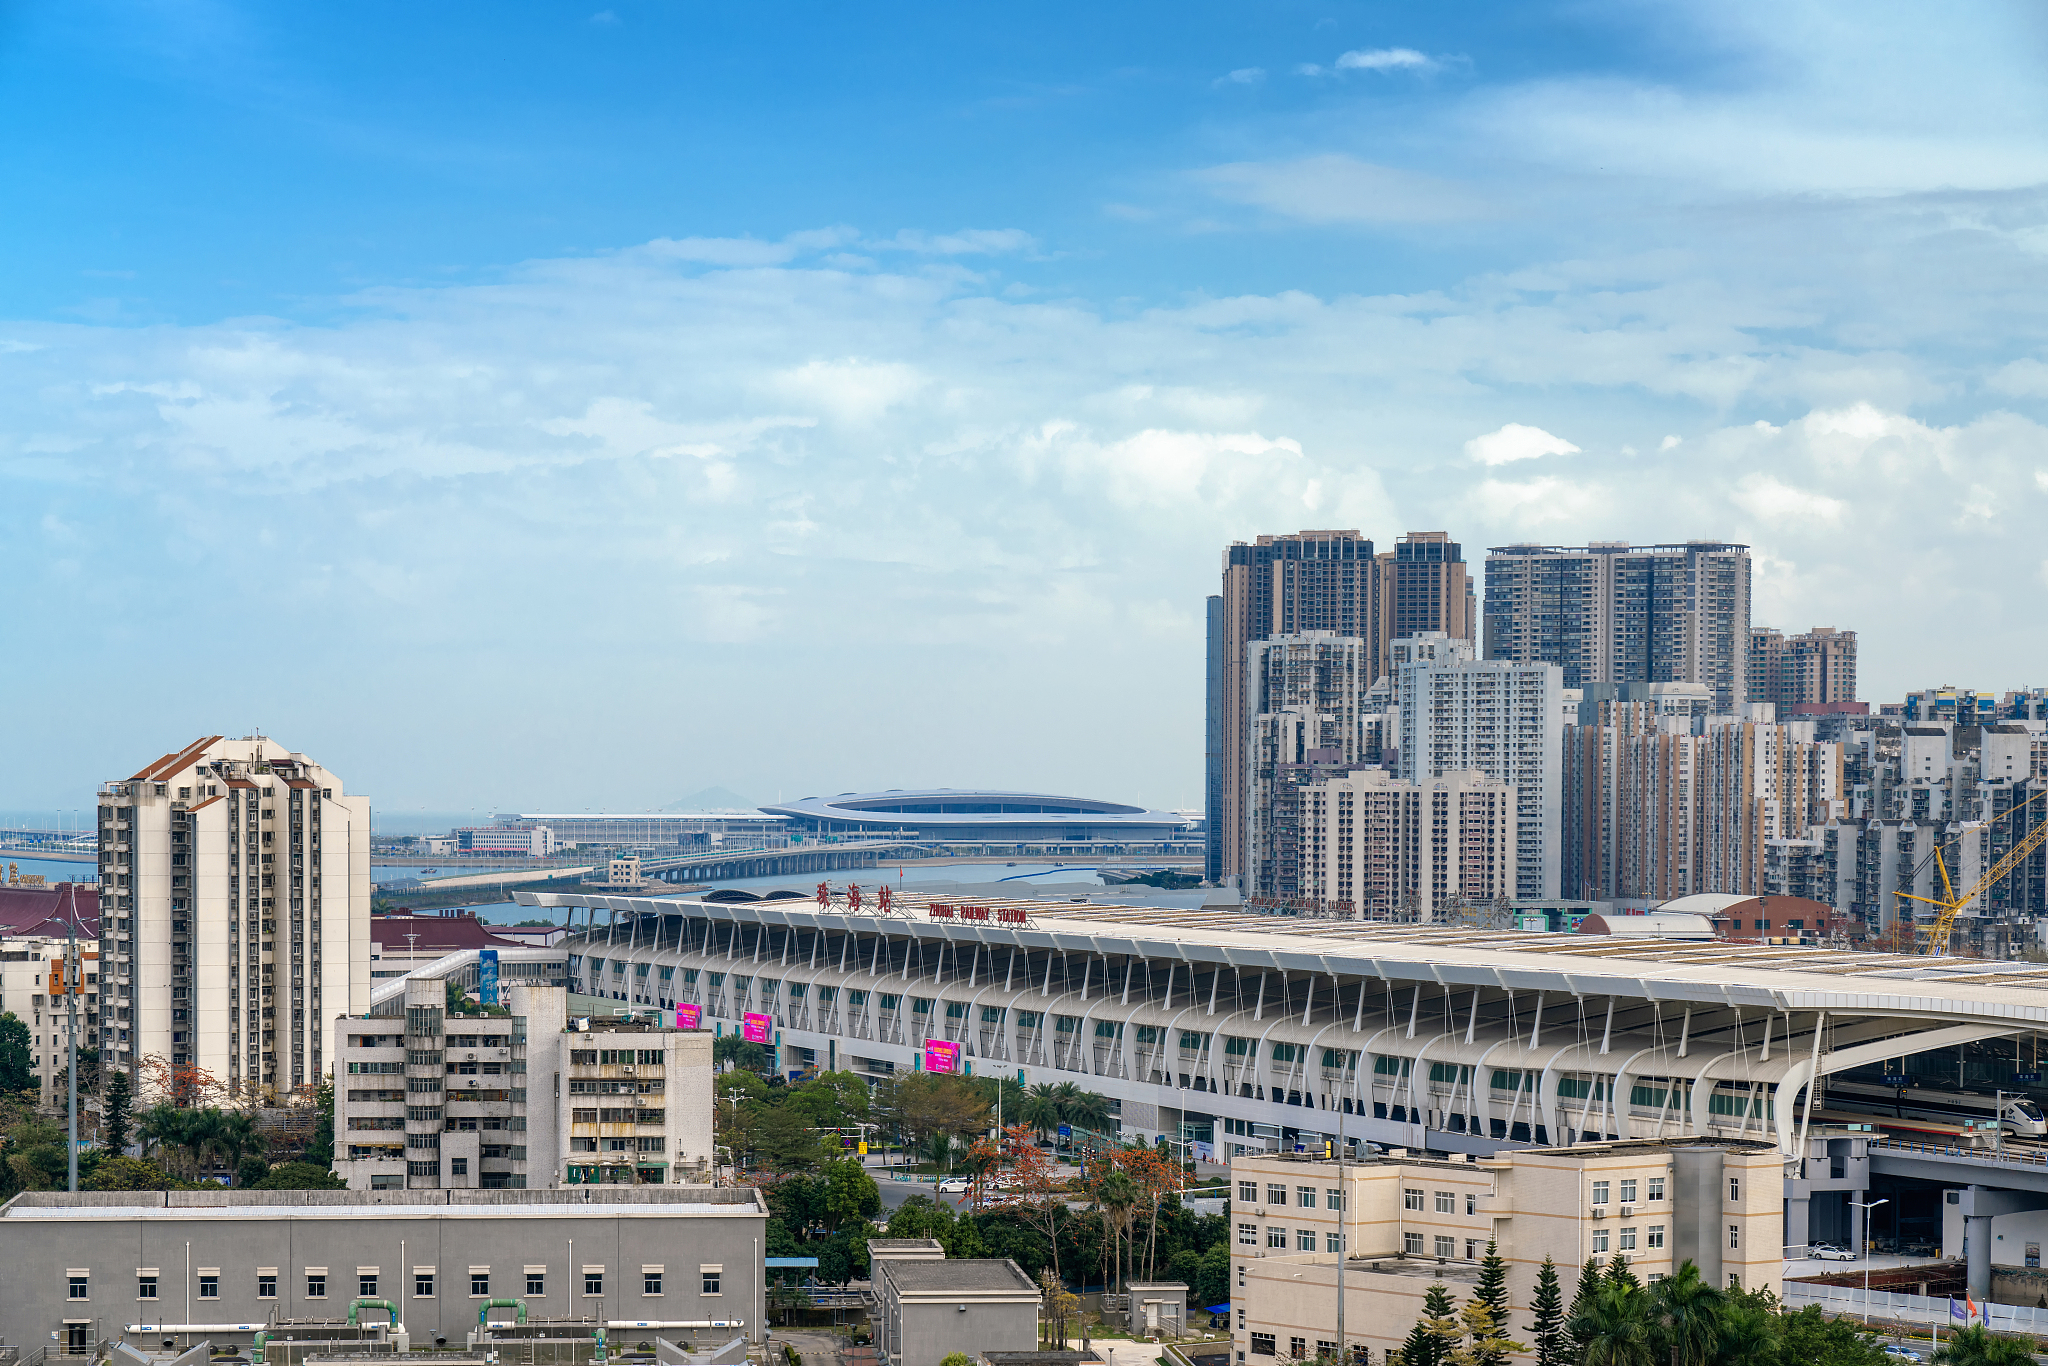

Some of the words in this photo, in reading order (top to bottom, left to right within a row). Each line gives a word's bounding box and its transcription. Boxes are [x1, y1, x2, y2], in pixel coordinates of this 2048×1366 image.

[817, 881, 892, 913] 珠海站
[929, 903, 954, 918] ZHUHAI
[960, 905, 990, 920] RAILWAY
[998, 908, 1026, 923] STATION
